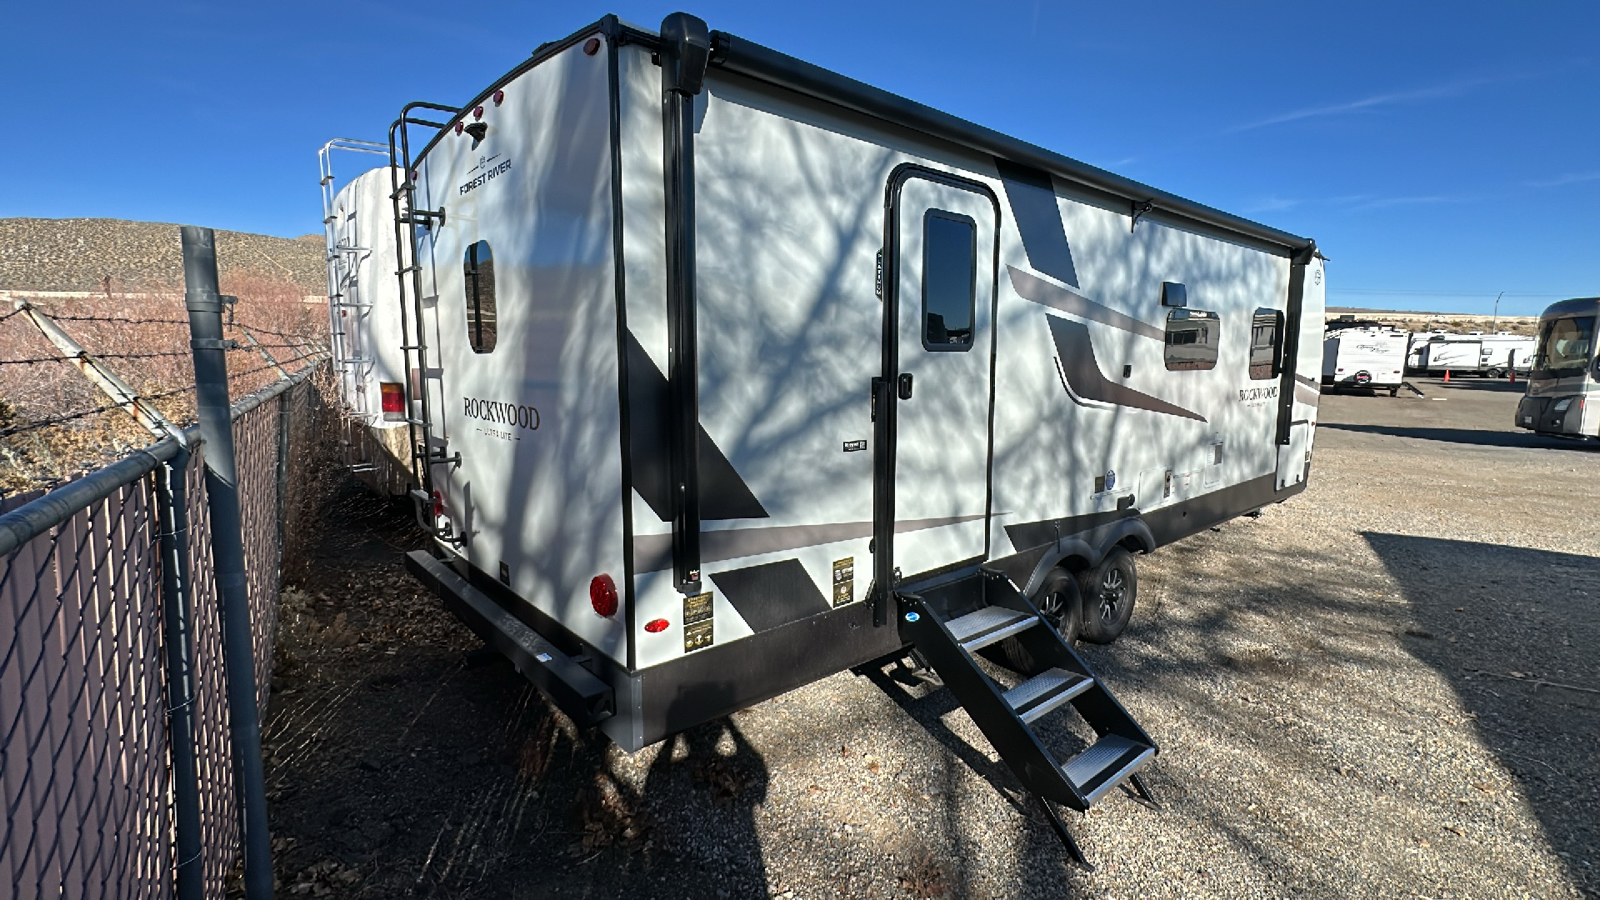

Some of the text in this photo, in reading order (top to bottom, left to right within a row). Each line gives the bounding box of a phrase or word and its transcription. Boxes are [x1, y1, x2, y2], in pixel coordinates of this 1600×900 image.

[460, 158, 512, 195] FOREST RIVER
[1239, 386, 1278, 402] ROCKWOOD
[463, 396, 540, 430] ROCKWOOD
